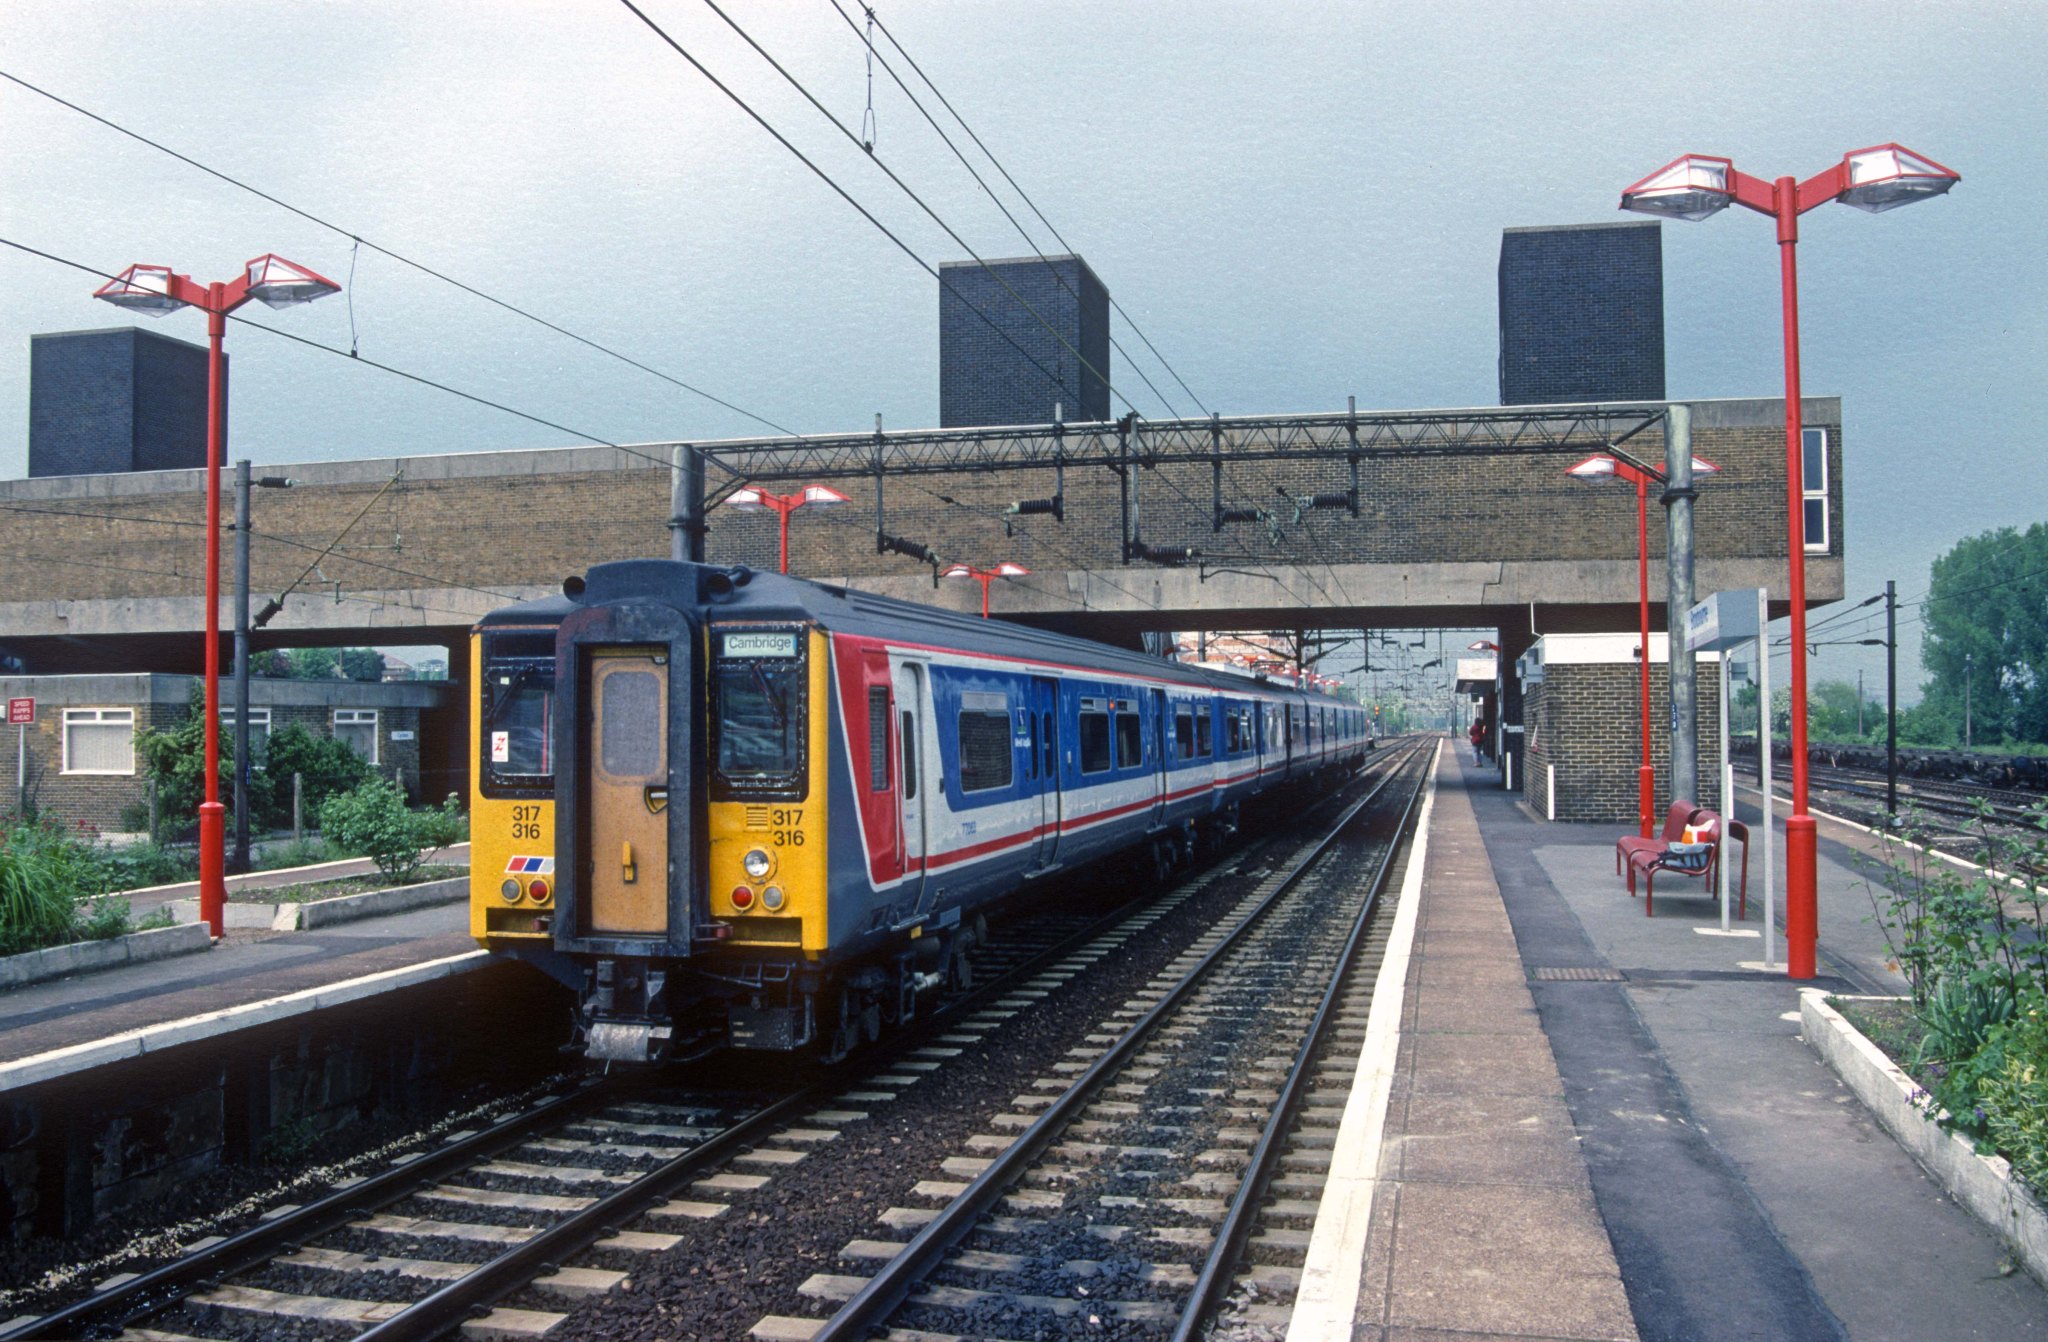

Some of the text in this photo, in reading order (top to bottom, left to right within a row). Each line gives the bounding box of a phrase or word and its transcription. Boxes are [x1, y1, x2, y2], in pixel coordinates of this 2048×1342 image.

[728, 636, 791, 651] Cambridge
[512, 805, 541, 821] 317
[773, 809, 803, 826] 317
[512, 822, 540, 839] 316
[773, 830, 805, 847] 316
